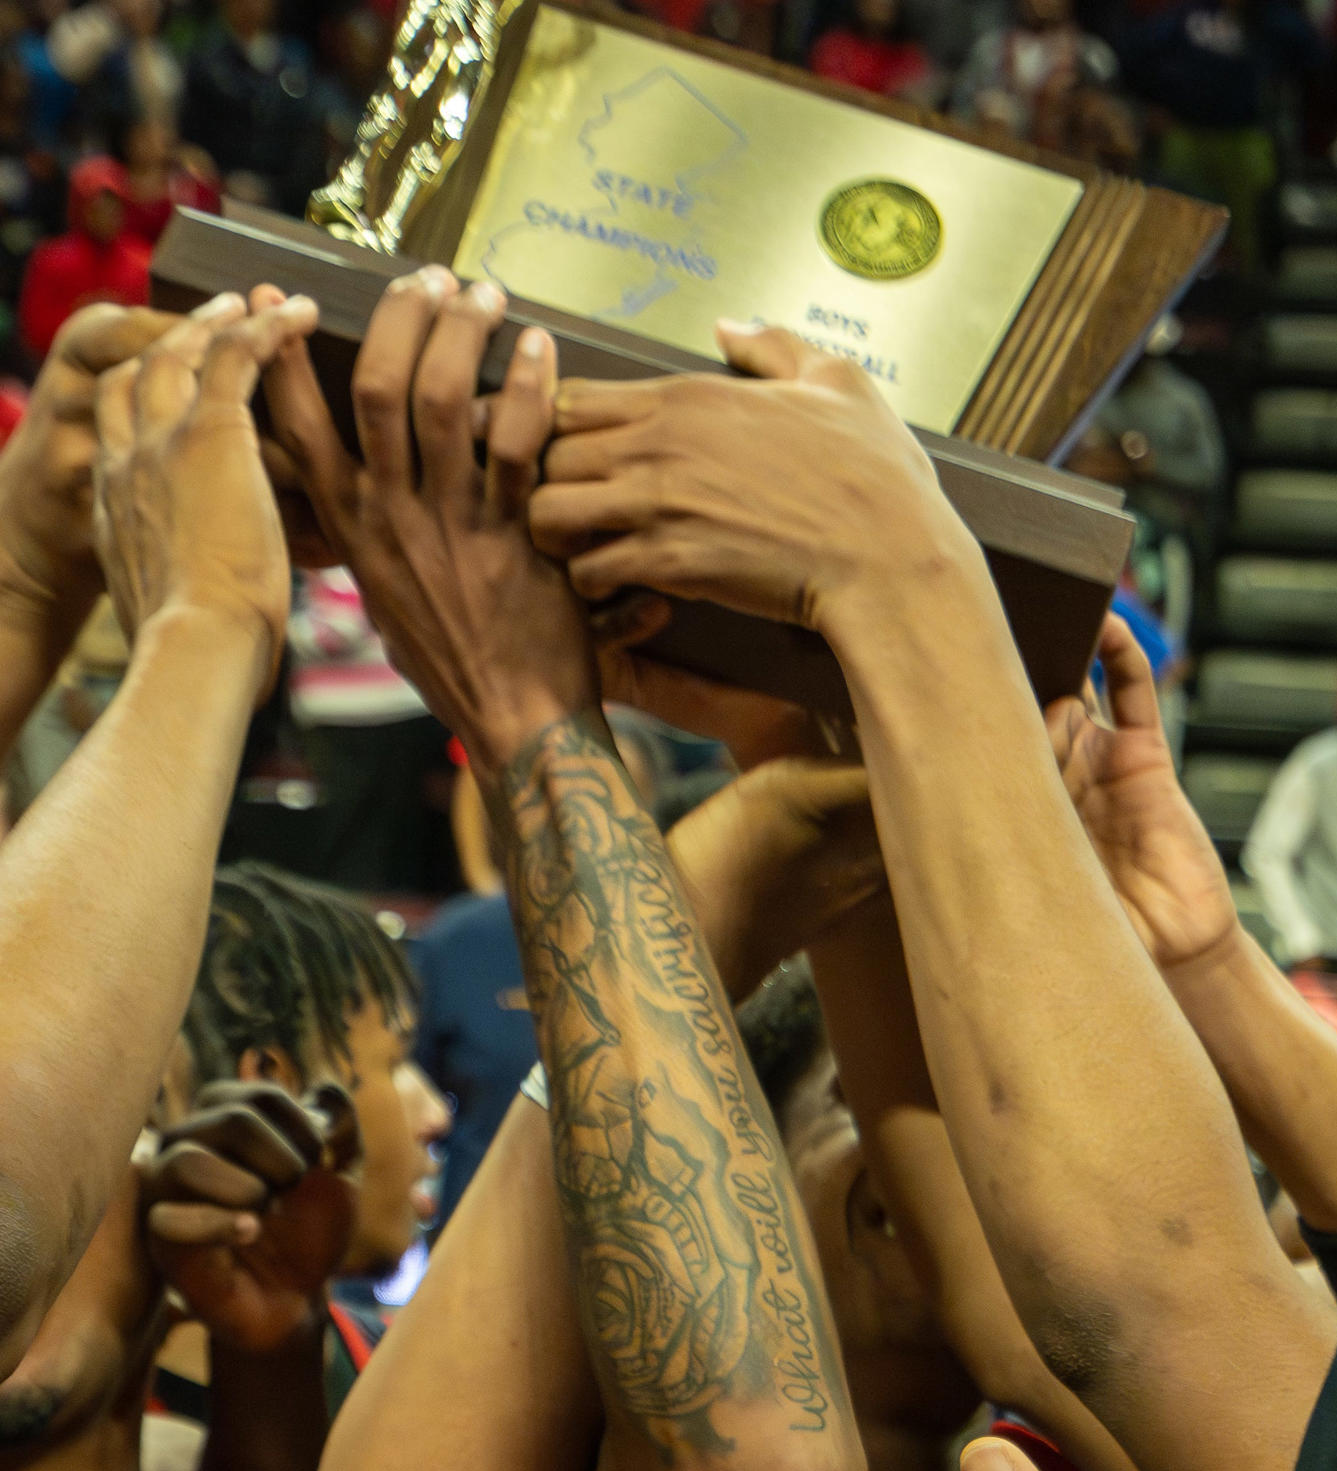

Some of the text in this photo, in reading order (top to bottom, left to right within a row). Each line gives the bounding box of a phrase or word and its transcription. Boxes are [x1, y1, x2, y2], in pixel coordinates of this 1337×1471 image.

[592, 169, 694, 220] STATE
[523, 200, 718, 280] CHAMPIONS
[807, 304, 870, 340] BOYS
[718, 1064, 774, 1163] you
[730, 1171, 793, 1274] will
[762, 1278, 828, 1433] What
